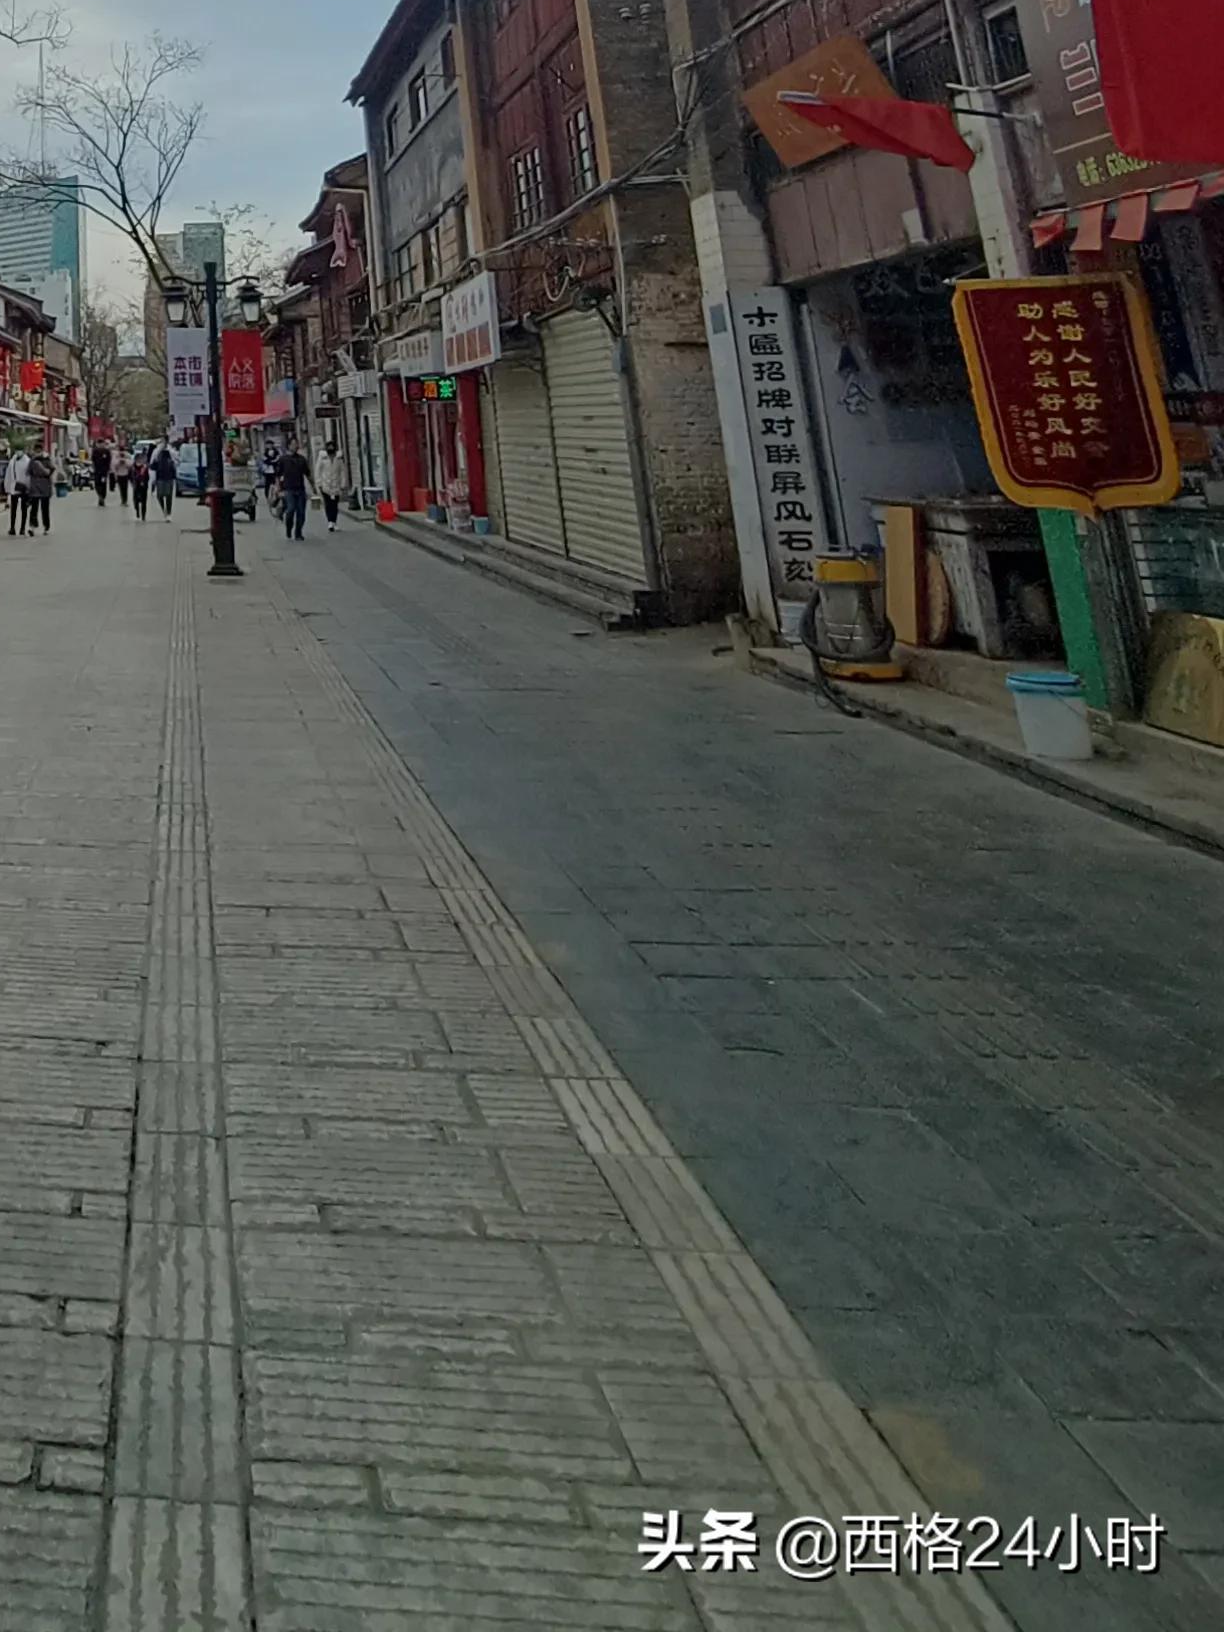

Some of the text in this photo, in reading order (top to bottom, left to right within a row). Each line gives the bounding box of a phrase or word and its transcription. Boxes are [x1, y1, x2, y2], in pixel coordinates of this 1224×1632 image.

[1017, 302, 1078, 460] 助人为乐好风尚
